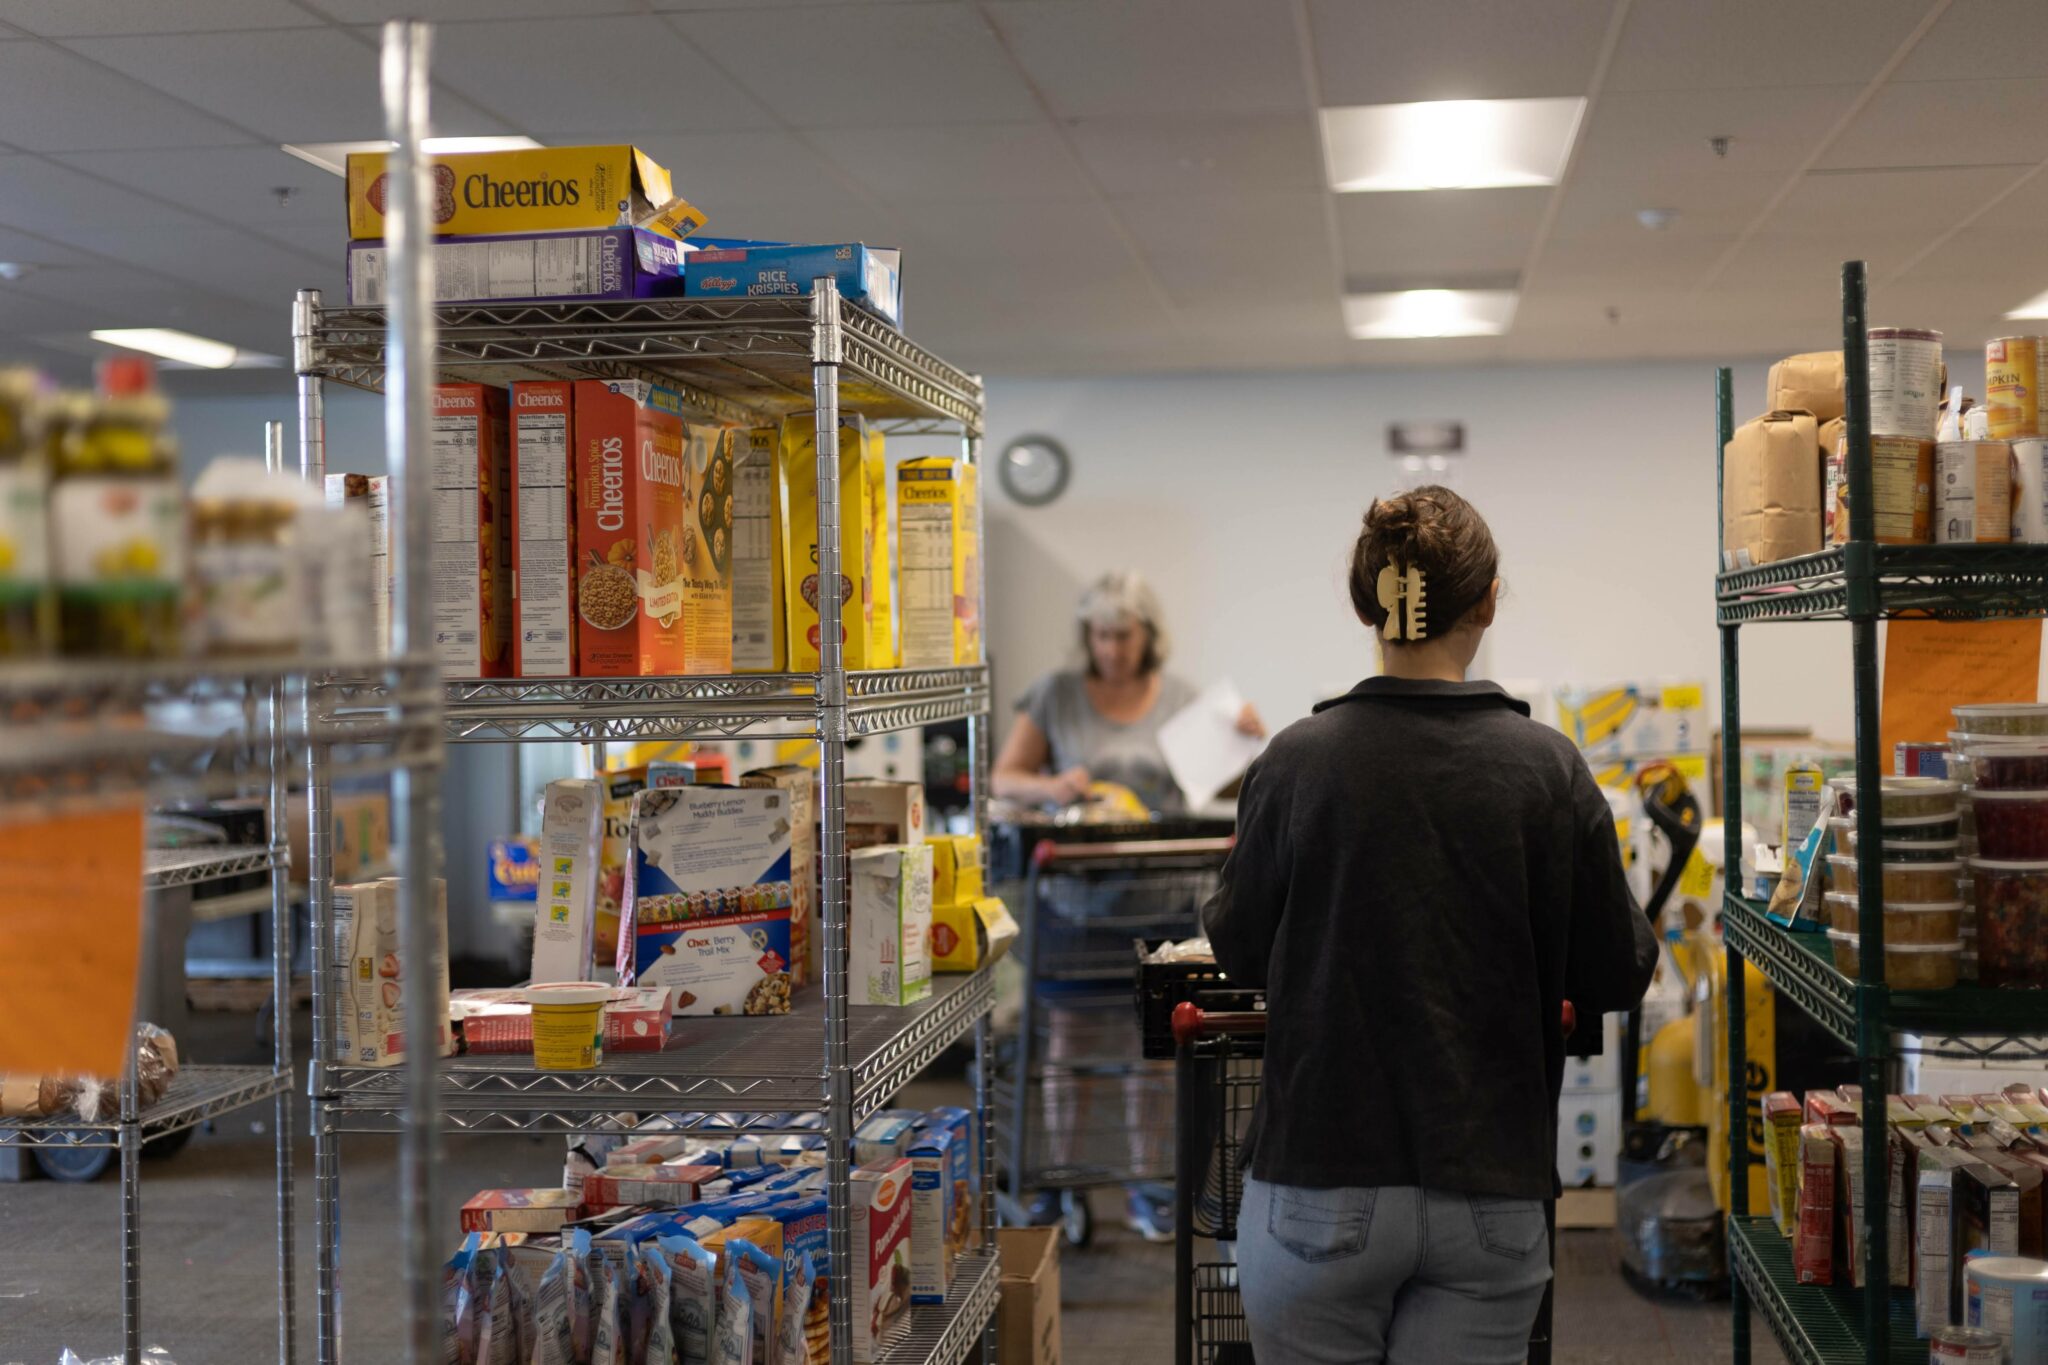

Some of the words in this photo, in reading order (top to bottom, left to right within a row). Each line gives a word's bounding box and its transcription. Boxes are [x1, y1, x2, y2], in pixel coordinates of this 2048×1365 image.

[463, 172, 580, 209] Cheerios
[602, 235, 619, 292] Cheerios
[700, 276, 737, 291] Kellogg's
[758, 271, 787, 283] RICE
[747, 282, 799, 297] KRISPIES
[517, 392, 563, 407] Cheerios
[641, 439, 680, 488] Cheerios
[597, 436, 624, 531] Cheerios
[904, 486, 948, 499] Cheerios
[688, 800, 722, 811] Blueberry
[722, 798, 746, 807] Lemon
[687, 938, 711, 949] Chex
[713, 935, 736, 946] Berry
[716, 945, 730, 955] Mix
